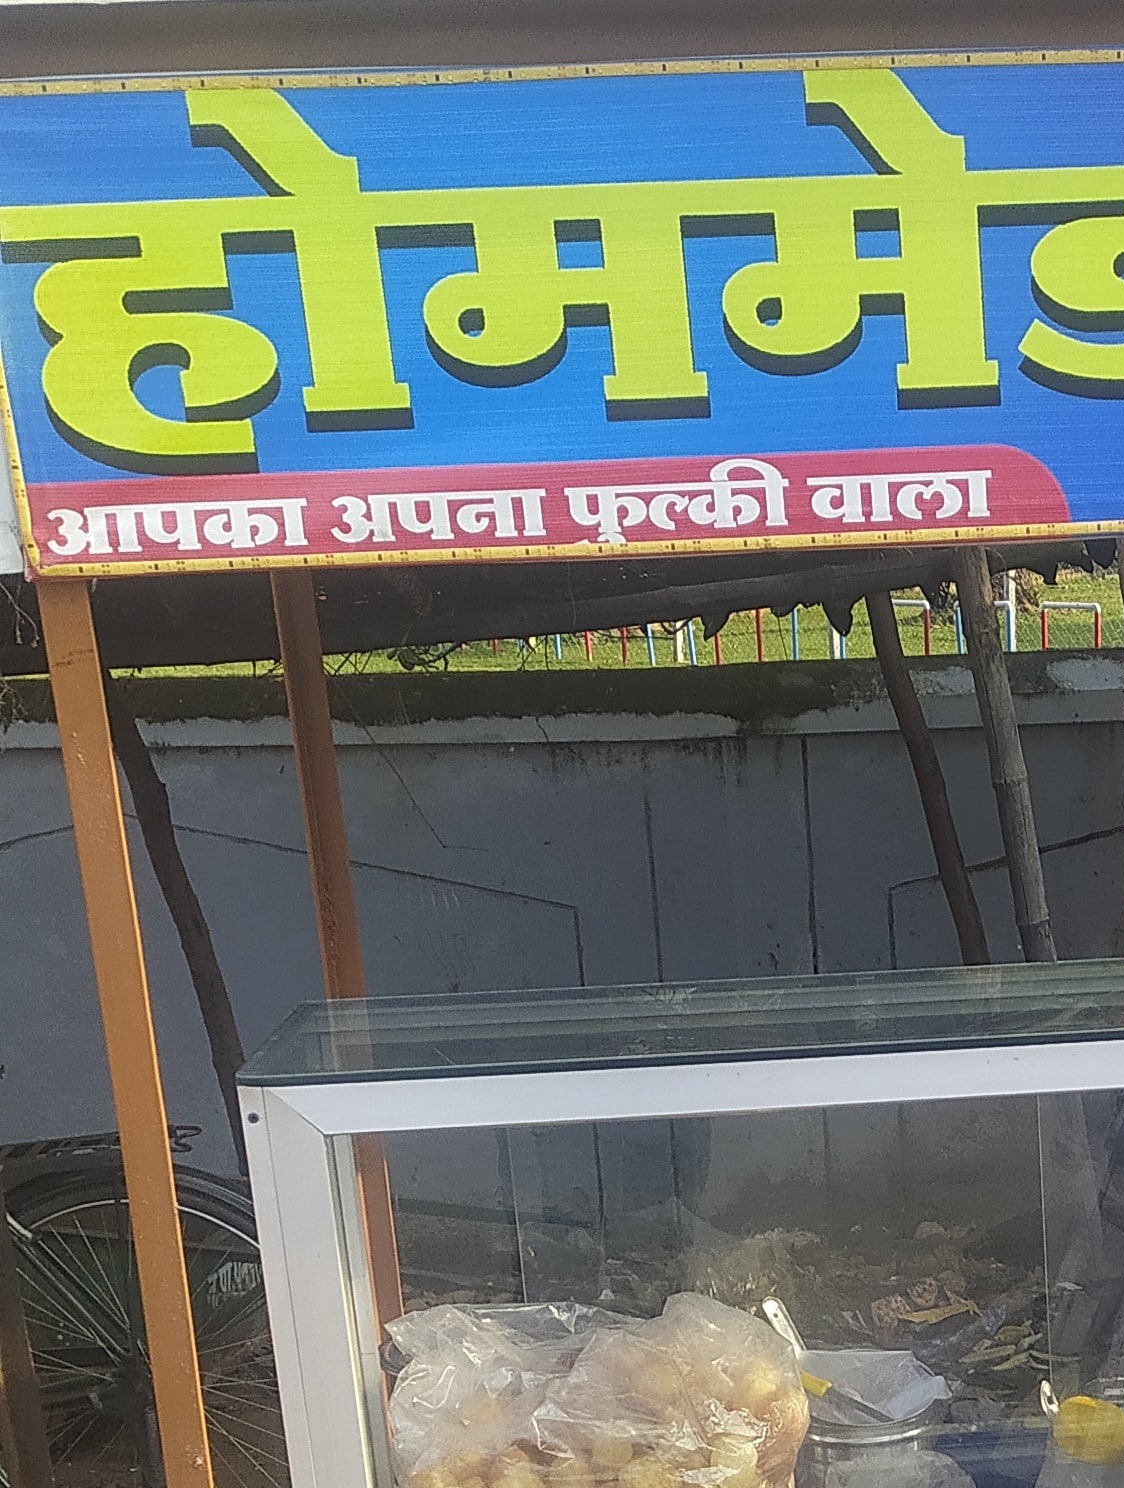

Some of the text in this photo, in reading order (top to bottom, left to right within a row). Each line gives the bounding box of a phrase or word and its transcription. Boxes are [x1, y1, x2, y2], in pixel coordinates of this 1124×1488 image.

[46, 498, 308, 556] आपका
[331, 488, 547, 544] अपना
[806, 468, 992, 525] वाला
